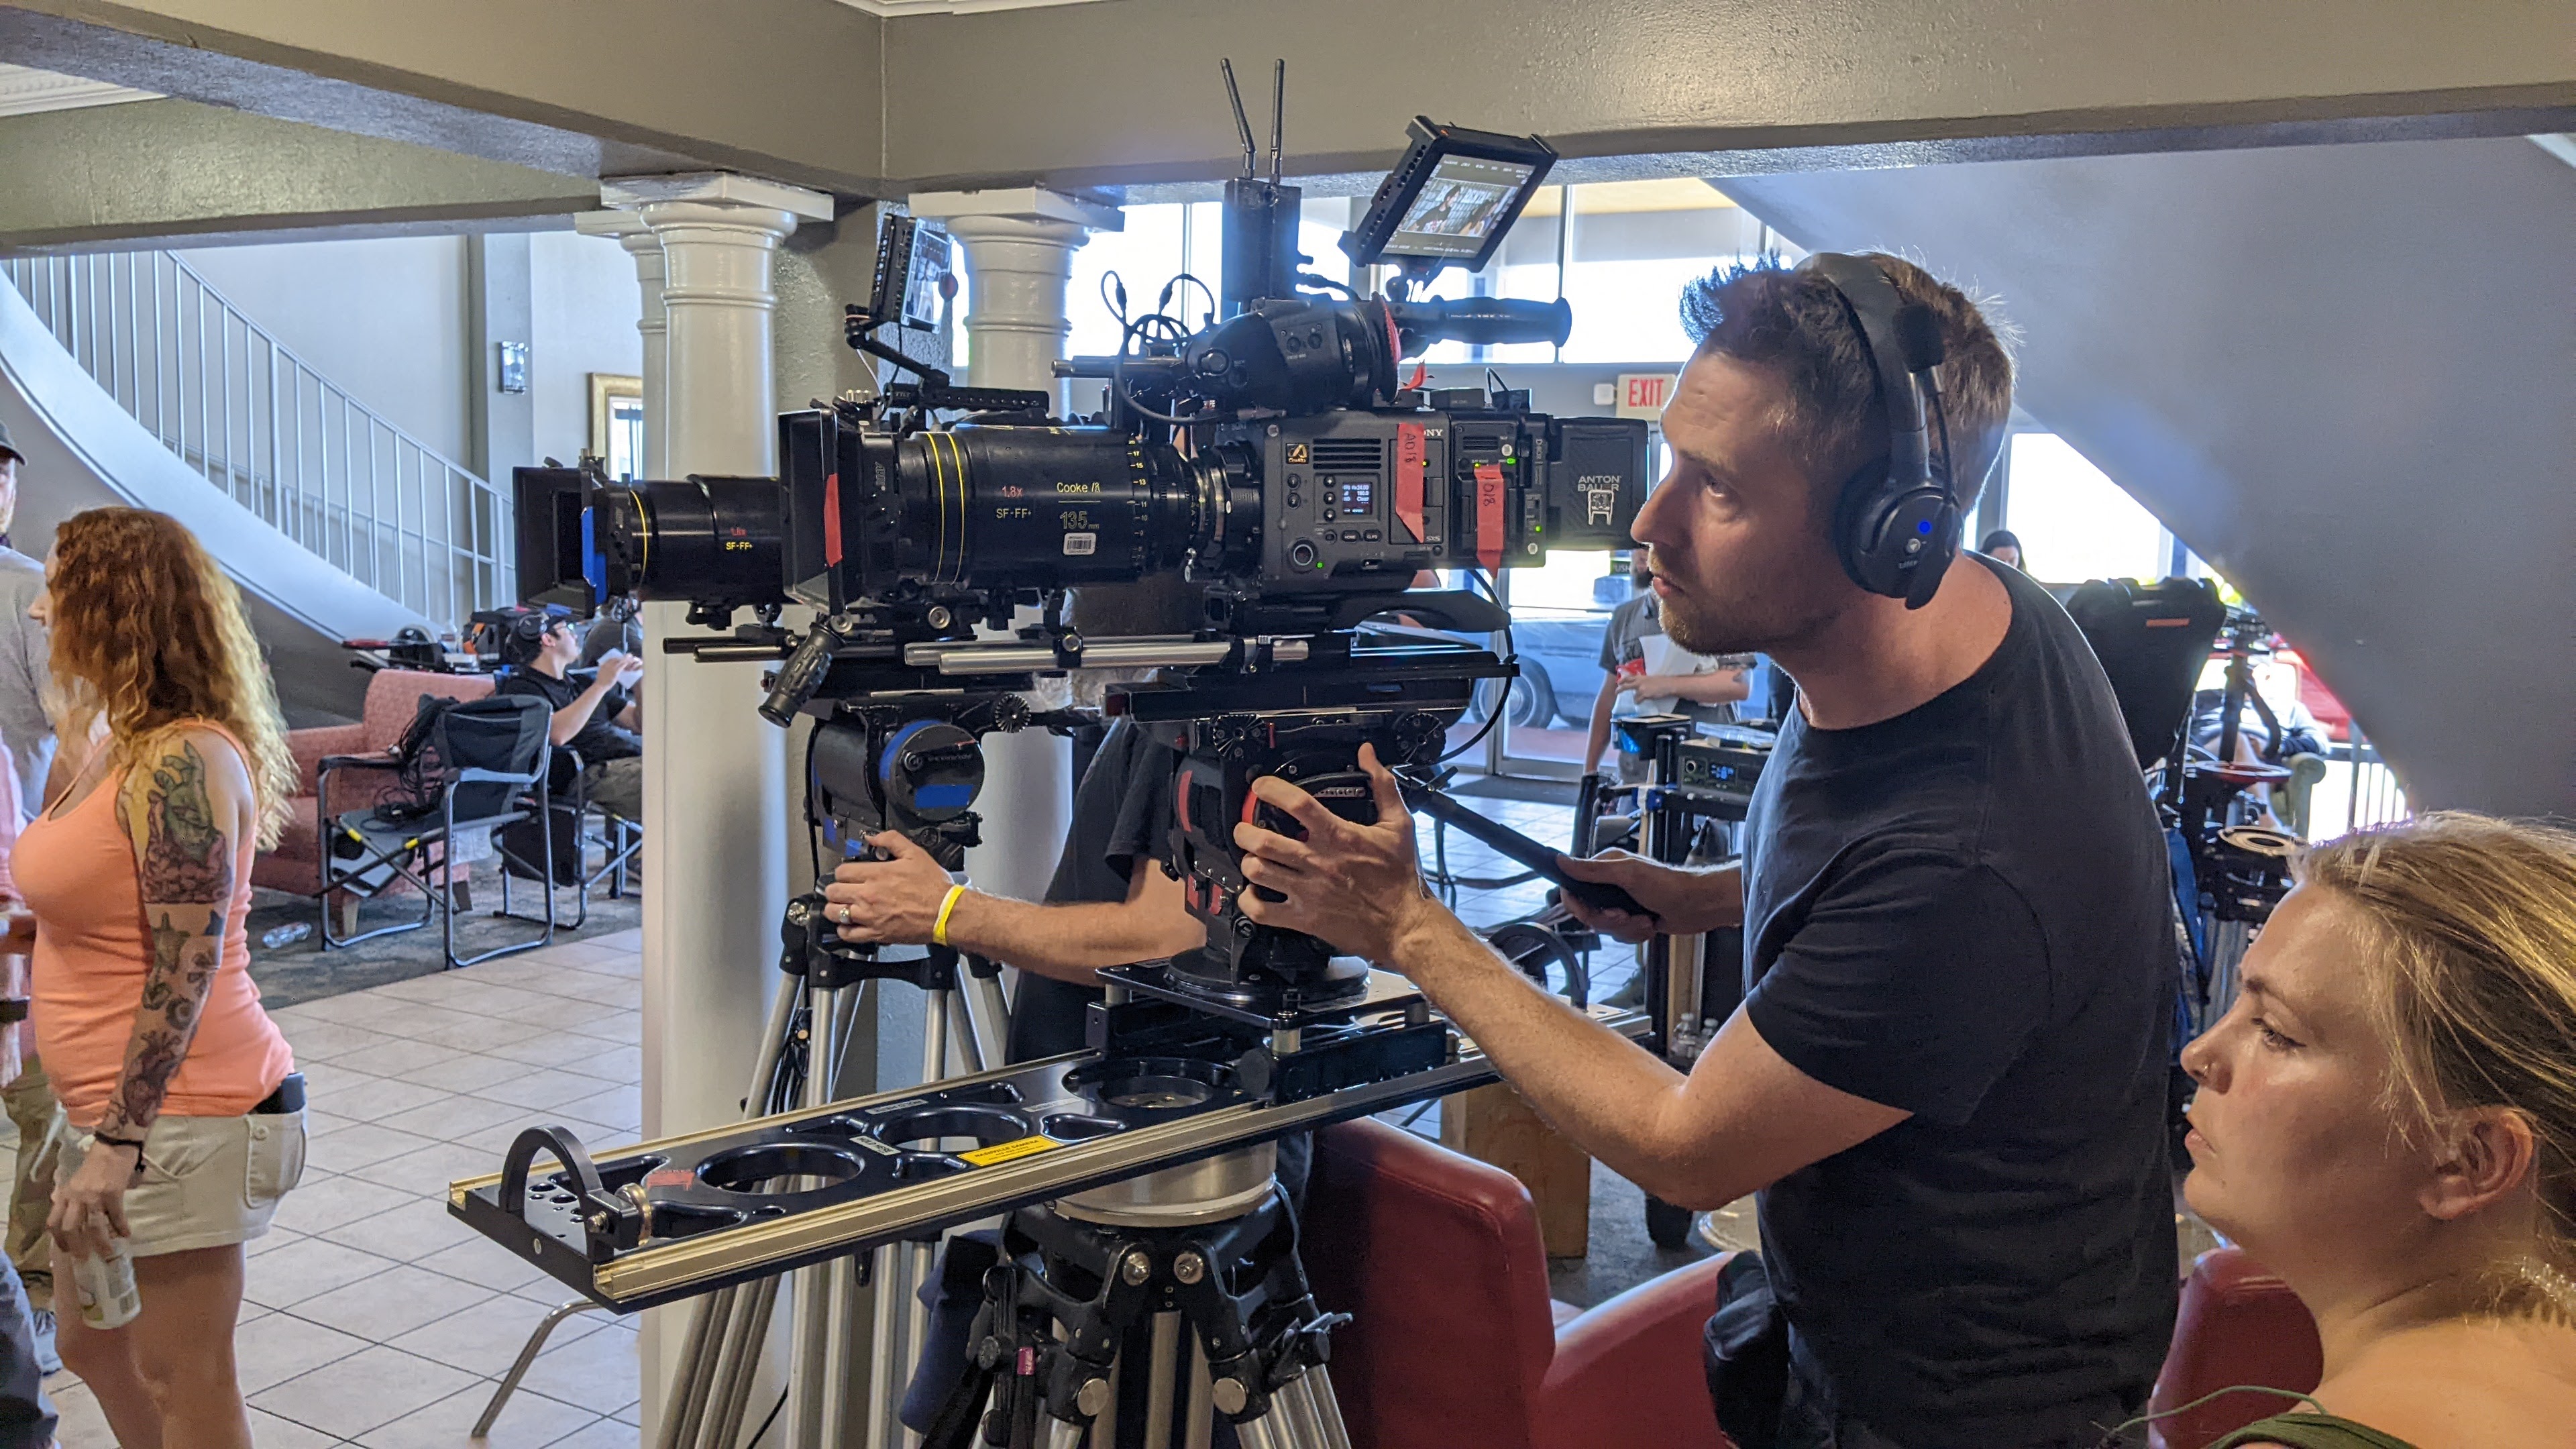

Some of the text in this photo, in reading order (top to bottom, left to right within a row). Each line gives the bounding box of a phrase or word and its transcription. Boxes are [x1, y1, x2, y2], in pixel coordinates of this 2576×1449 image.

[1629, 380, 1664, 407] EXIT
[1578, 476, 1619, 484] ANTON
[1002, 485, 1024, 497] 1.8x
[1057, 482, 1088, 493] Cooke
[1577, 484, 1619, 492] BAUR
